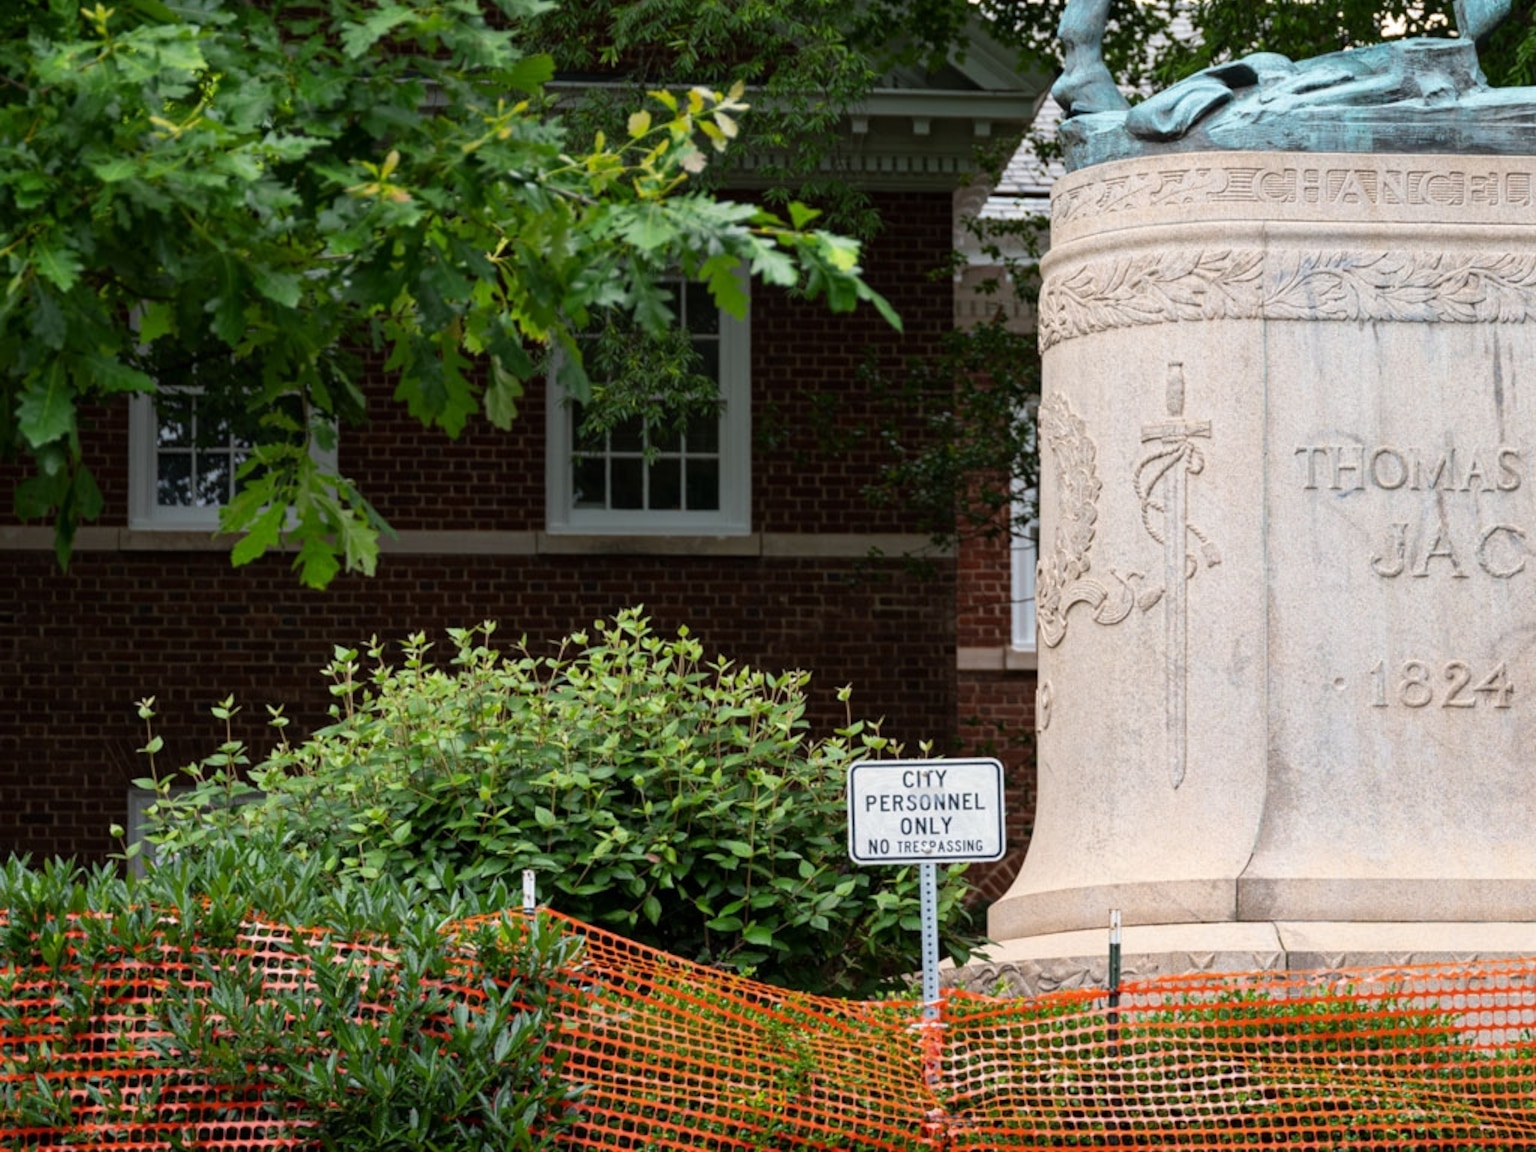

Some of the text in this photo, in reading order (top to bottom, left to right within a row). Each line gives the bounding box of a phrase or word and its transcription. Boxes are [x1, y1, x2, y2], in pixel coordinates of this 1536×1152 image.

[1294, 446, 1522, 493] THOMAS
[1369, 659, 1515, 710] 1824
[902, 770, 947, 788] CITY
[866, 793, 986, 812] PERSONNEL
[900, 816, 952, 835] ONLY
[869, 839, 984, 855] NO TRESPASSING
